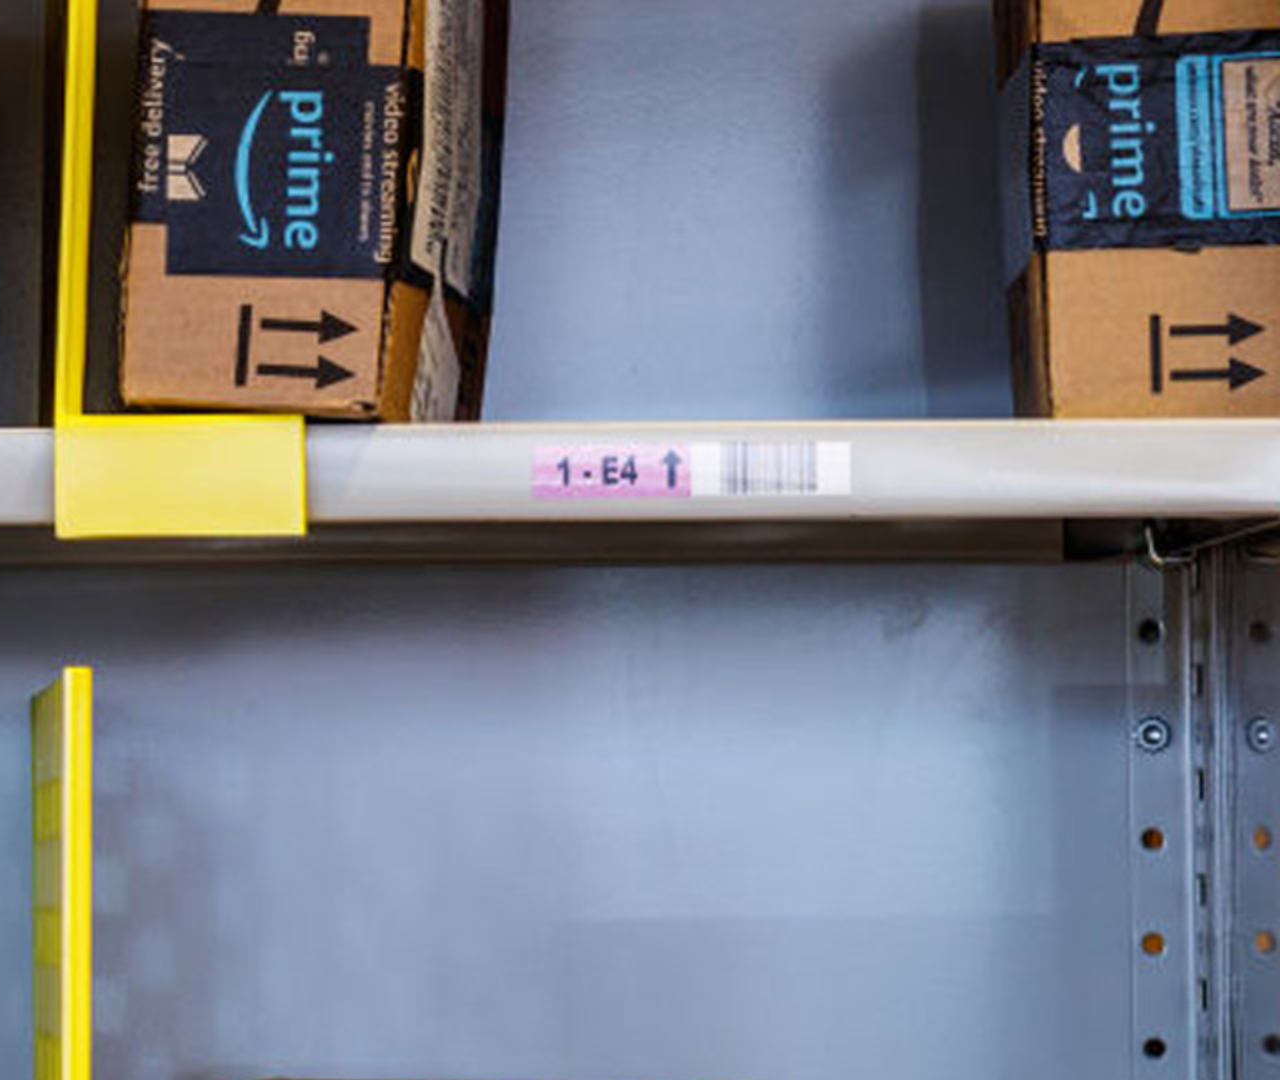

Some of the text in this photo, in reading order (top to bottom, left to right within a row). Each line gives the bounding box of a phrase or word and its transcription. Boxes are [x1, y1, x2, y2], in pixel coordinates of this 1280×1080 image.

[137, 39, 175, 192] free delivery
[279, 90, 336, 249] prime
[374, 83, 403, 263] video streaming
[1096, 63, 1156, 219] prime
[603, 457, 638, 485] E4
